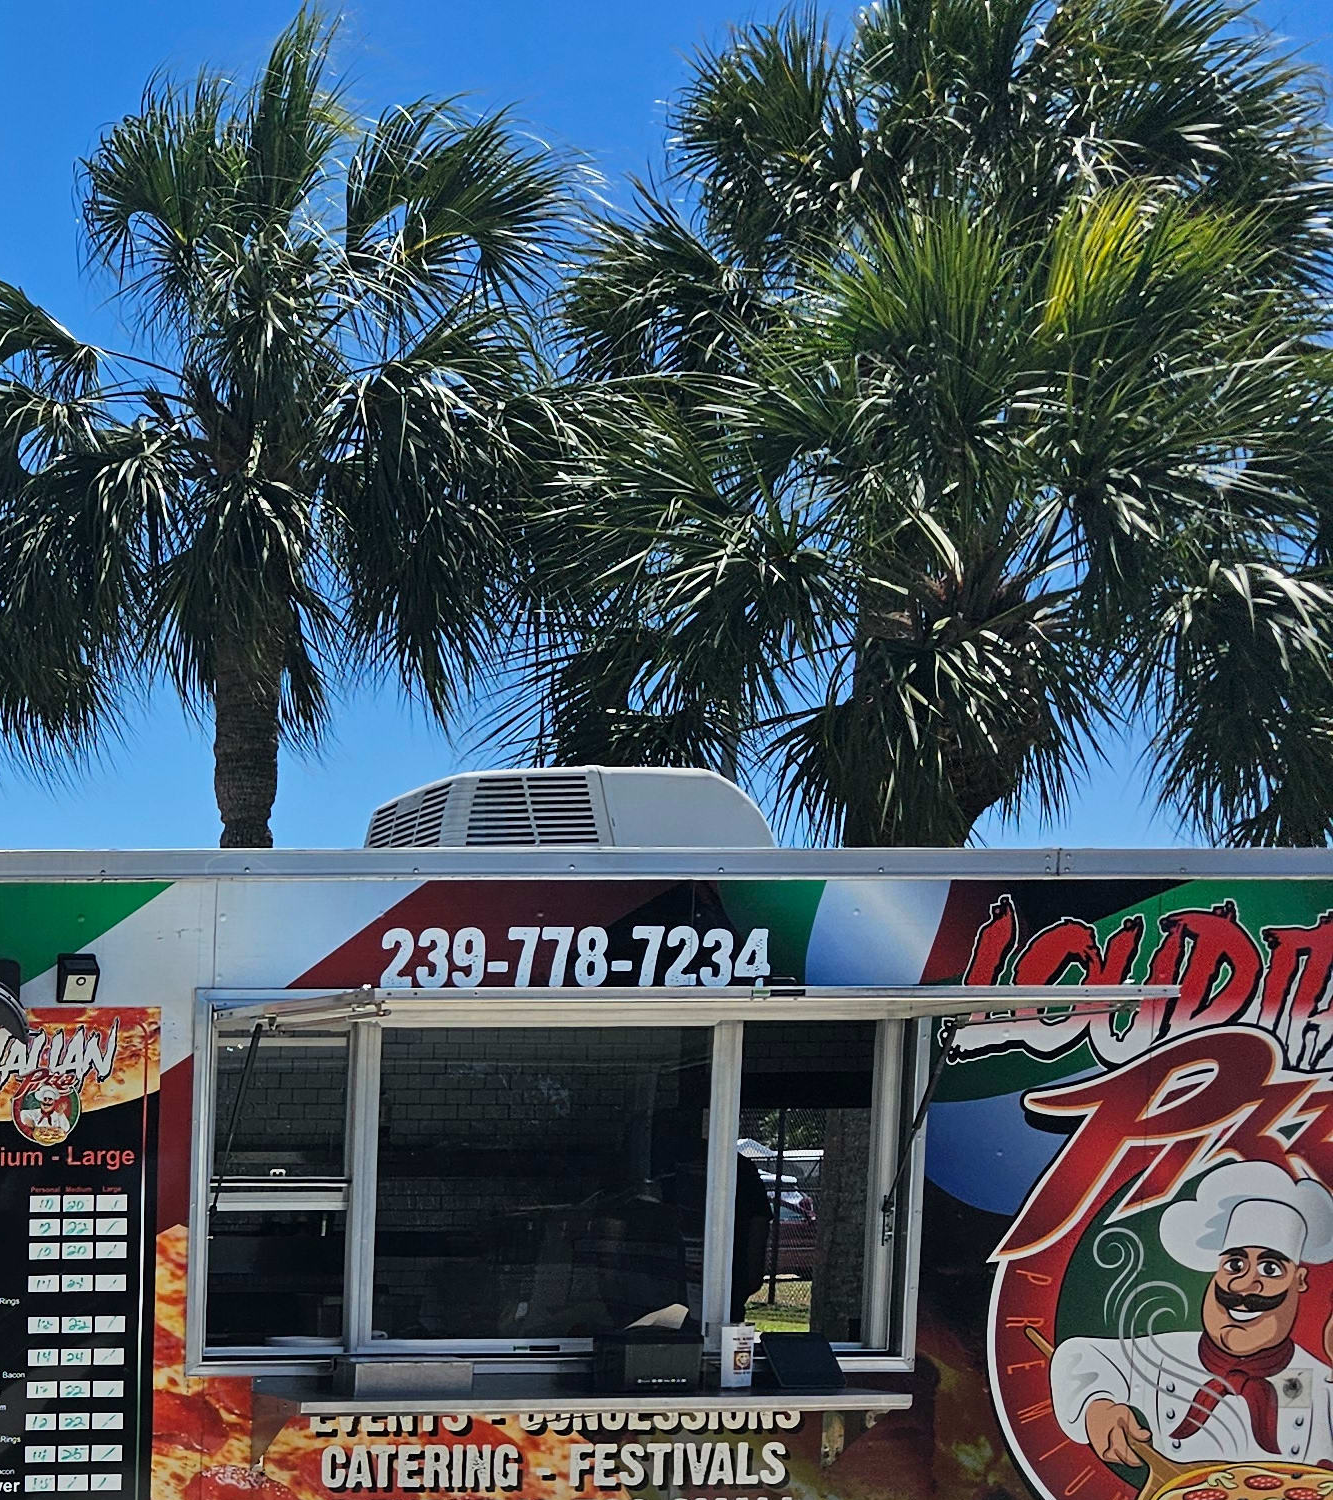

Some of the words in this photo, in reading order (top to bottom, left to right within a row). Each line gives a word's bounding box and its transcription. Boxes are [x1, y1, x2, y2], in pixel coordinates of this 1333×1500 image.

[379, 925, 770, 987] 239-778-7234
[66, 1147, 135, 1170] Large
[67, 1352, 83, 1362] 24
[321, 1444, 520, 1489] CATERING
[570, 1441, 788, 1487] FESTIVALS
